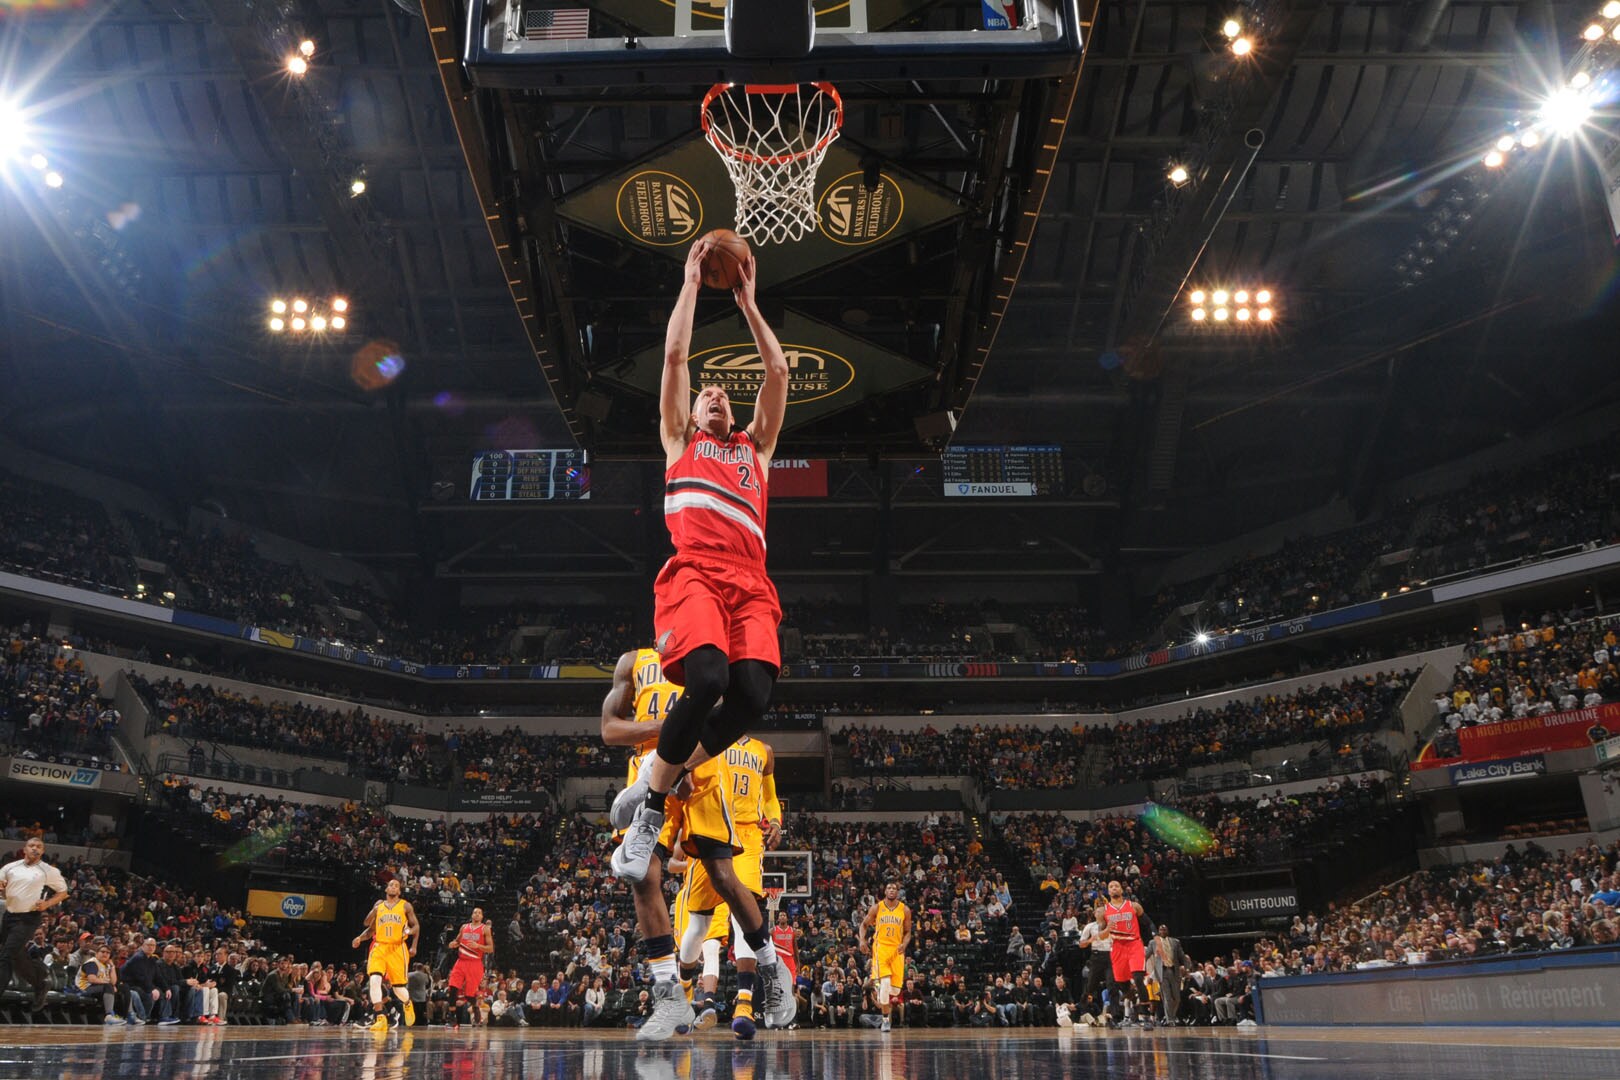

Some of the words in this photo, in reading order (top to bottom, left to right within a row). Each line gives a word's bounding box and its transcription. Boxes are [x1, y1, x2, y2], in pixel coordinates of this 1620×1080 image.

[988, 18, 1006, 27] NBA
[635, 181, 653, 237] FIELDHOUSE
[651, 181, 665, 222] BANKERS
[853, 199, 867, 237] BANKERS
[700, 372, 792, 380] BANKE
[795, 372, 829, 380] LIFE
[694, 440, 754, 467] PORTLAN
[971, 485, 1018, 494] FANDUEL
[852, 664, 861, 677] 2
[1476, 724, 1502, 738] HIGH
[1503, 717, 1543, 734] OCTANE
[1543, 708, 1600, 728] DRUMLINE
[12, 763, 72, 780] SECTION
[724, 748, 763, 775] DIANA
[1459, 767, 1487, 780] Lake
[1488, 763, 1511, 777] City
[1513, 759, 1544, 773] Bank
[734, 772, 749, 796] 13
[283, 898, 304, 915] Kroger
[1230, 895, 1296, 911] LIGHTBOUND
[1430, 985, 1479, 1012] Health
[1501, 982, 1606, 1009] Retirement
